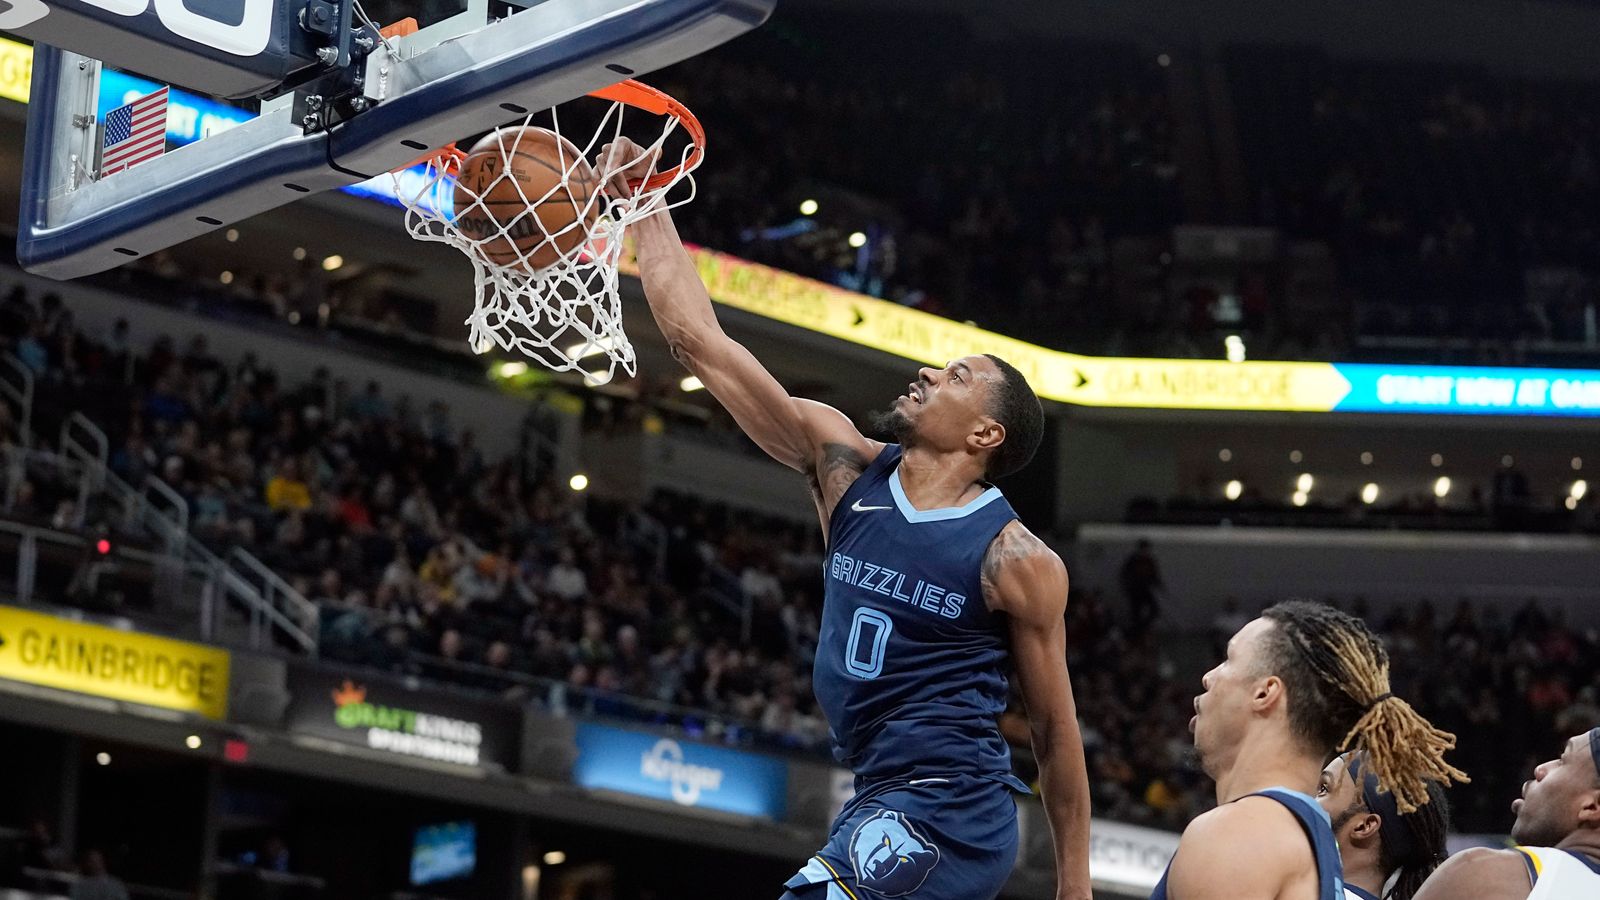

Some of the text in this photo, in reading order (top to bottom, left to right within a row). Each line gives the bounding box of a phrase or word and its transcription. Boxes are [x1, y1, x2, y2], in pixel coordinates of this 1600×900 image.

[1105, 368, 1292, 399] GAINBRIDGE
[832, 552, 966, 619] GRIZZLIES
[18, 628, 214, 703] GAINBRIDGE
[845, 606, 893, 681] 0
